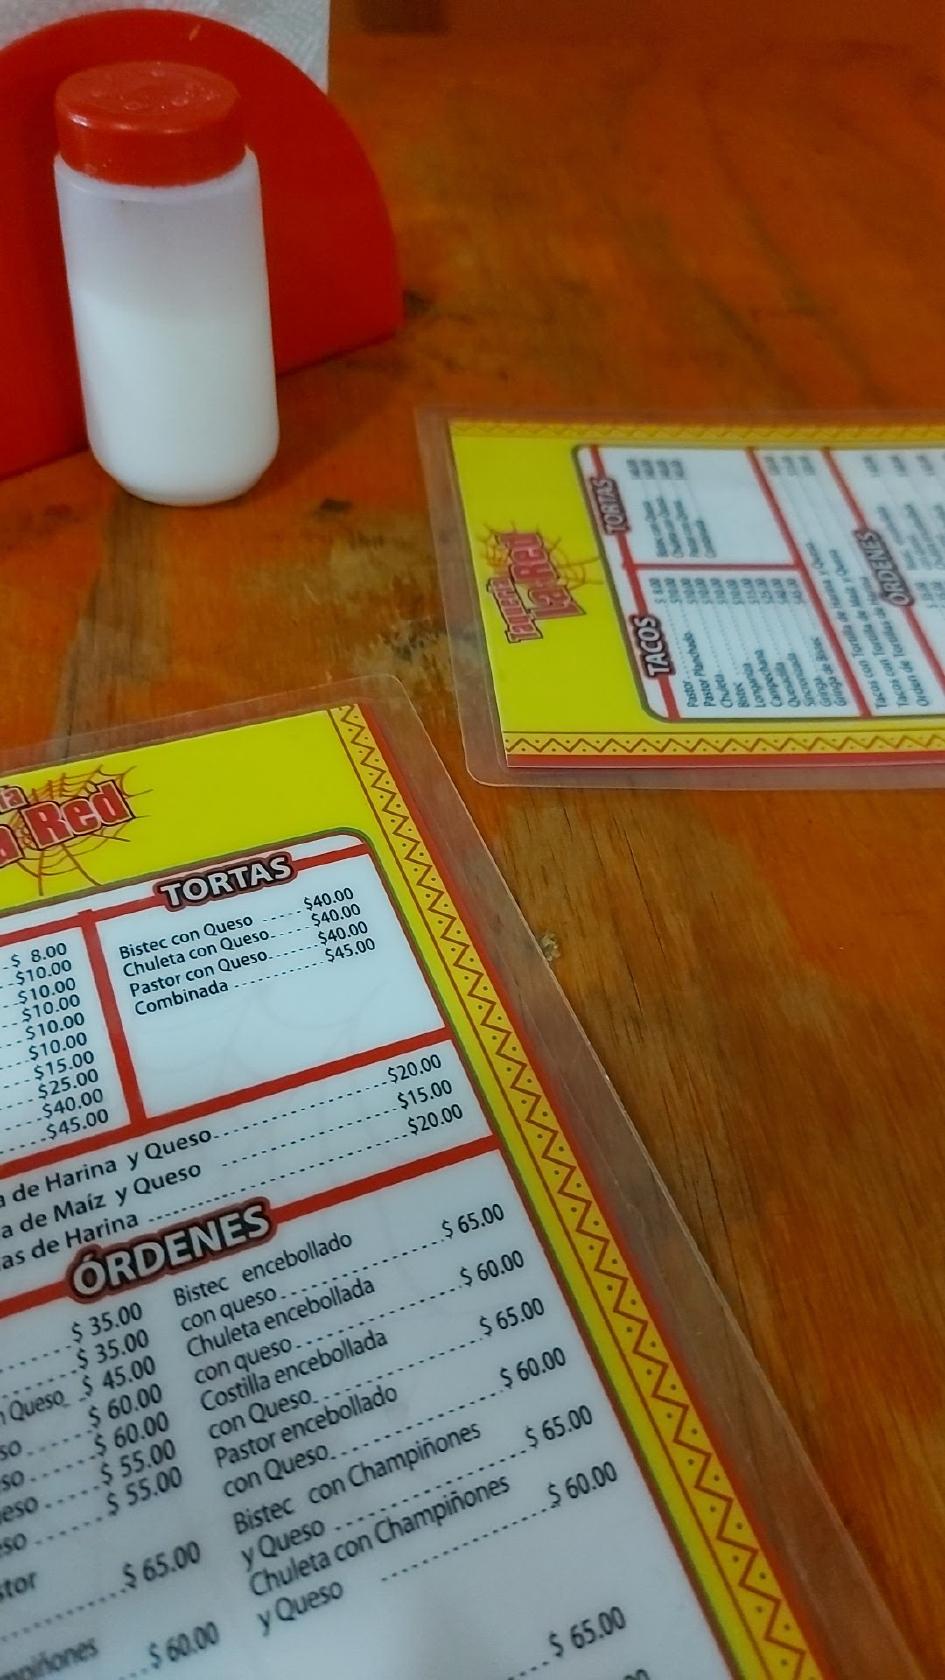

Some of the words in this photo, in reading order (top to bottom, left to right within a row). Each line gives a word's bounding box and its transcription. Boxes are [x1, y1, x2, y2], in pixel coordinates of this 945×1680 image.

[593, 480, 626, 534] TORTAS
[497, 532, 558, 582] Red
[634, 617, 669, 676] TACOS
[684, 632, 706, 676] Planchado
[881, 659, 894, 676] con
[715, 674, 733, 707] Chuleta
[859, 661, 873, 678] con
[908, 675, 929, 706] Orden
[683, 680, 698, 707] Pastor
[699, 679, 716, 706] Pastor
[871, 681, 886, 708] Tacos
[892, 679, 908, 706] Tacos
[20, 780, 134, 849] Red
[160, 856, 293, 906] TORTAS
[119, 937, 169, 960] Bistec
[170, 929, 201, 945] con
[203, 914, 254, 937] Queso
[303, 887, 355, 911] $40.00
[123, 952, 186, 978] Chuleta
[189, 944, 217, 960] con
[219, 929, 270, 952] Queso
[311, 904, 361, 927] $40.00
[15, 959, 72, 986] $10.00
[30, 942, 68, 963] 8.00
[129, 973, 182, 997] Pastor
[185, 964, 215, 981] con
[217, 949, 268, 973] Queso
[317, 921, 369, 945] $40.00
[17, 978, 76, 1005] $10.00
[134, 979, 229, 1016] Combinada
[325, 938, 376, 963] $45.00
[22, 994, 81, 1022] $10.00
[25, 1012, 85, 1040] $10.00
[28, 1032, 88, 1060] $10.00
[33, 1051, 95, 1080] $15.00
[37, 1069, 99, 1100] $25.00
[41, 1089, 104, 1119] $40.00
[12, 1183, 40, 1203] de
[45, 1160, 117, 1194] Harina
[127, 1151, 139, 1170] y
[144, 1128, 213, 1160] Queso
[387, 1054, 442, 1083] $20.00
[46, 1108, 109, 1140] $45.00
[20, 1211, 47, 1232] de
[54, 1194, 107, 1223] Maíz
[115, 1186, 128, 1205] y
[134, 1162, 201, 1195] Queso
[397, 1079, 453, 1111] $15.00
[32, 1237, 60, 1259] de
[65, 1214, 138, 1249] Harina
[407, 1103, 464, 1136] $20.00
[72, 1206, 270, 1296] ÓRDENES
[173, 1274, 230, 1307] Bistec
[242, 1231, 353, 1283] encebollado
[181, 1308, 216, 1332] con
[220, 1288, 278, 1319] queso
[458, 1203, 505, 1235] 65.00
[89, 1302, 144, 1335] 35.00
[187, 1319, 261, 1358] Chuleta
[263, 1277, 375, 1332] encebollada
[194, 1358, 231, 1384] con
[234, 1336, 292, 1374] queso
[477, 1249, 525, 1281] 60.00
[94, 1329, 150, 1362] 35.00
[10, 1390, 65, 1421] Queso
[102, 1355, 156, 1390] 45.00
[201, 1370, 271, 1412] Costilla
[274, 1328, 388, 1385] encebollada
[207, 1412, 245, 1440] con
[248, 1390, 312, 1423] Queso
[496, 1298, 546, 1331] 65.00
[108, 1383, 162, 1419] 60.00
[114, 1411, 169, 1448] 60.00
[214, 1434, 278, 1468] Pastor
[281, 1386, 399, 1444] encebollado
[223, 1470, 262, 1499] con
[264, 1446, 329, 1481] Queso
[516, 1347, 567, 1383] 60.00
[120, 1439, 176, 1478] 55.00
[234, 1494, 296, 1536] Bistec
[307, 1475, 348, 1505] con
[348, 1422, 481, 1488] Champiñones
[126, 1466, 183, 1506] 55.00
[240, 1547, 256, 1572] y
[256, 1519, 326, 1558] Queso
[541, 1404, 594, 1441] 65.00
[249, 1550, 332, 1598] Chuleta
[334, 1533, 374, 1562] con
[374, 1475, 510, 1543] Champiñones
[256, 1607, 273, 1636] y
[275, 1581, 345, 1622] Queso
[565, 1461, 619, 1500] 60.00
[143, 1541, 201, 1582] 65.00
[166, 1621, 220, 1662] 60.00
[570, 1606, 626, 1649] 65.00
